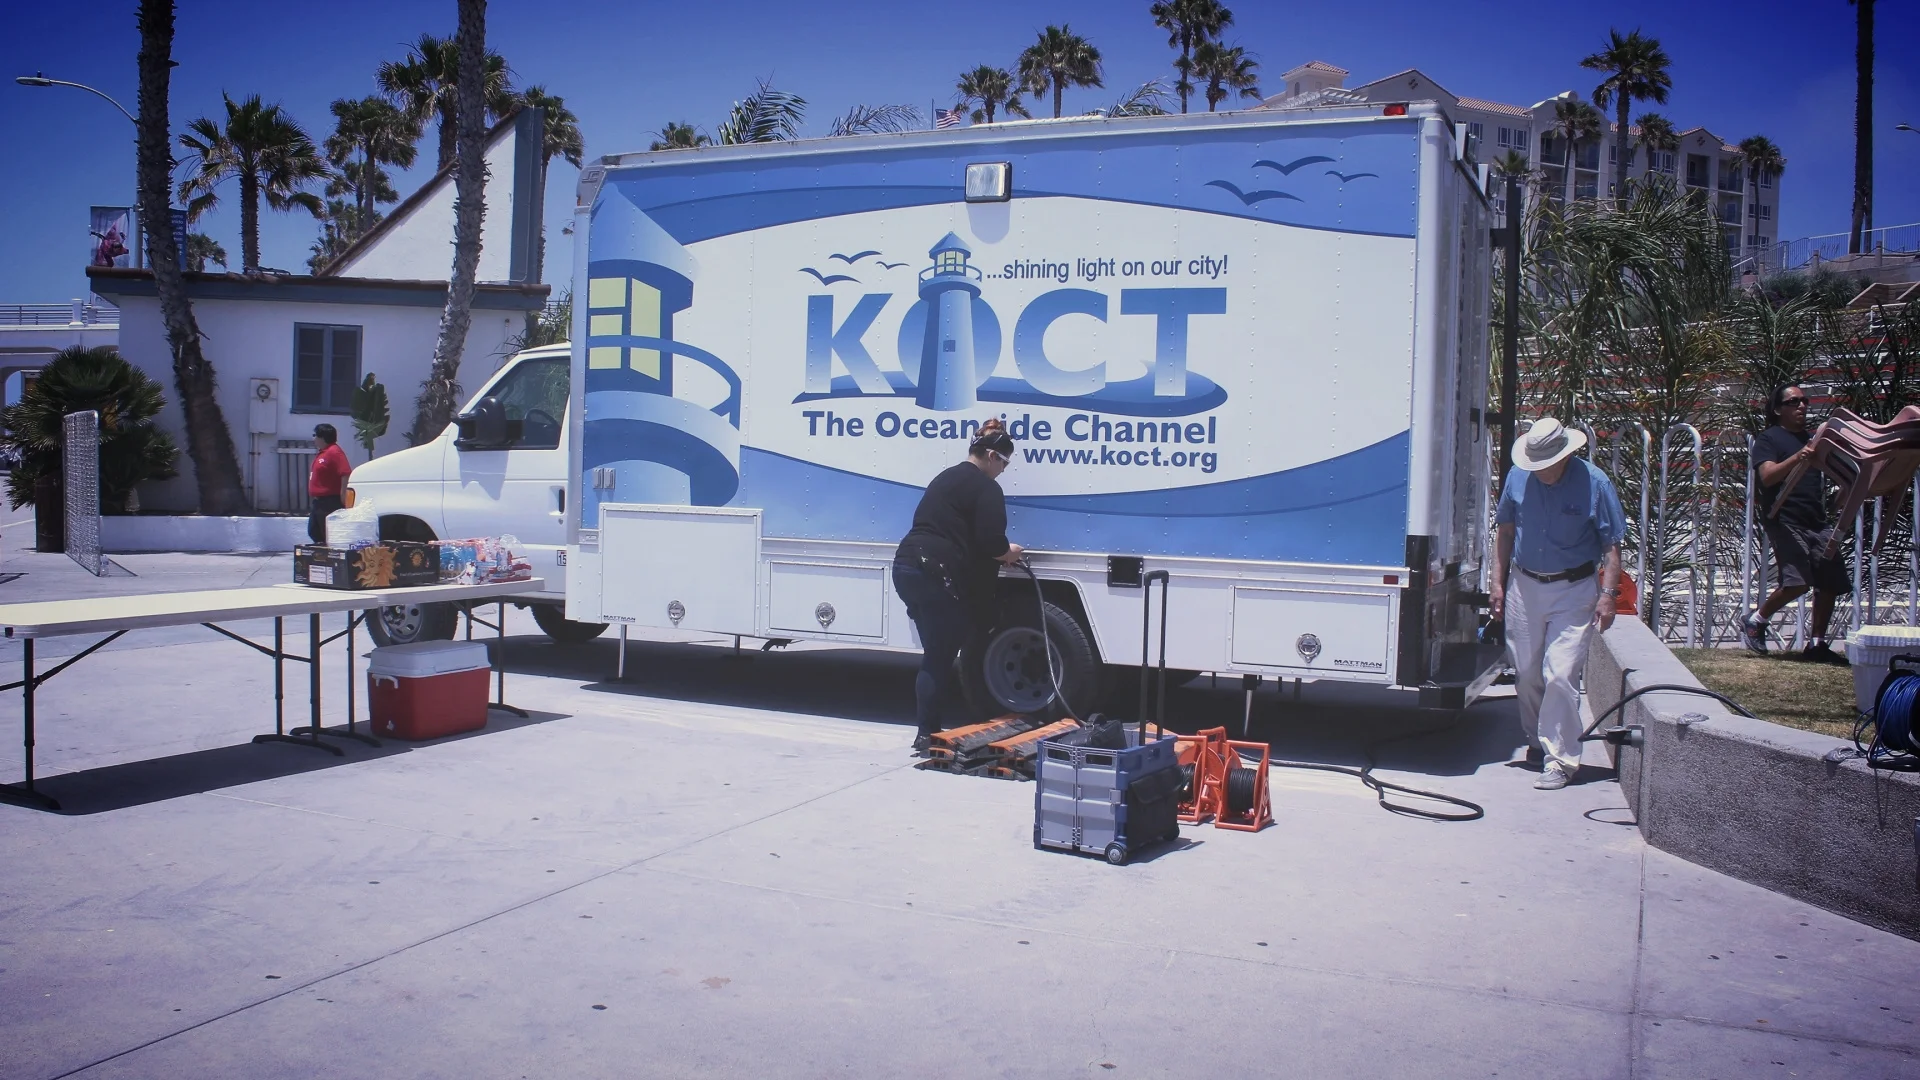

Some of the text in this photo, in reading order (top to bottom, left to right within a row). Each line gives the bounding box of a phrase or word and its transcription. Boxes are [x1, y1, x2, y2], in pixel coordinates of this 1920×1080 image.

[1077, 257, 1116, 282] light
[1122, 261, 1145, 277] on
[1150, 259, 1183, 276] our
[1188, 254, 1229, 280] city!
[804, 287, 1228, 397] KOCT
[802, 411, 1217, 444] The Oceanide Channel
[1023, 445, 1218, 474] www.koct.org
[1333, 659, 1383, 667] MATTMAN
